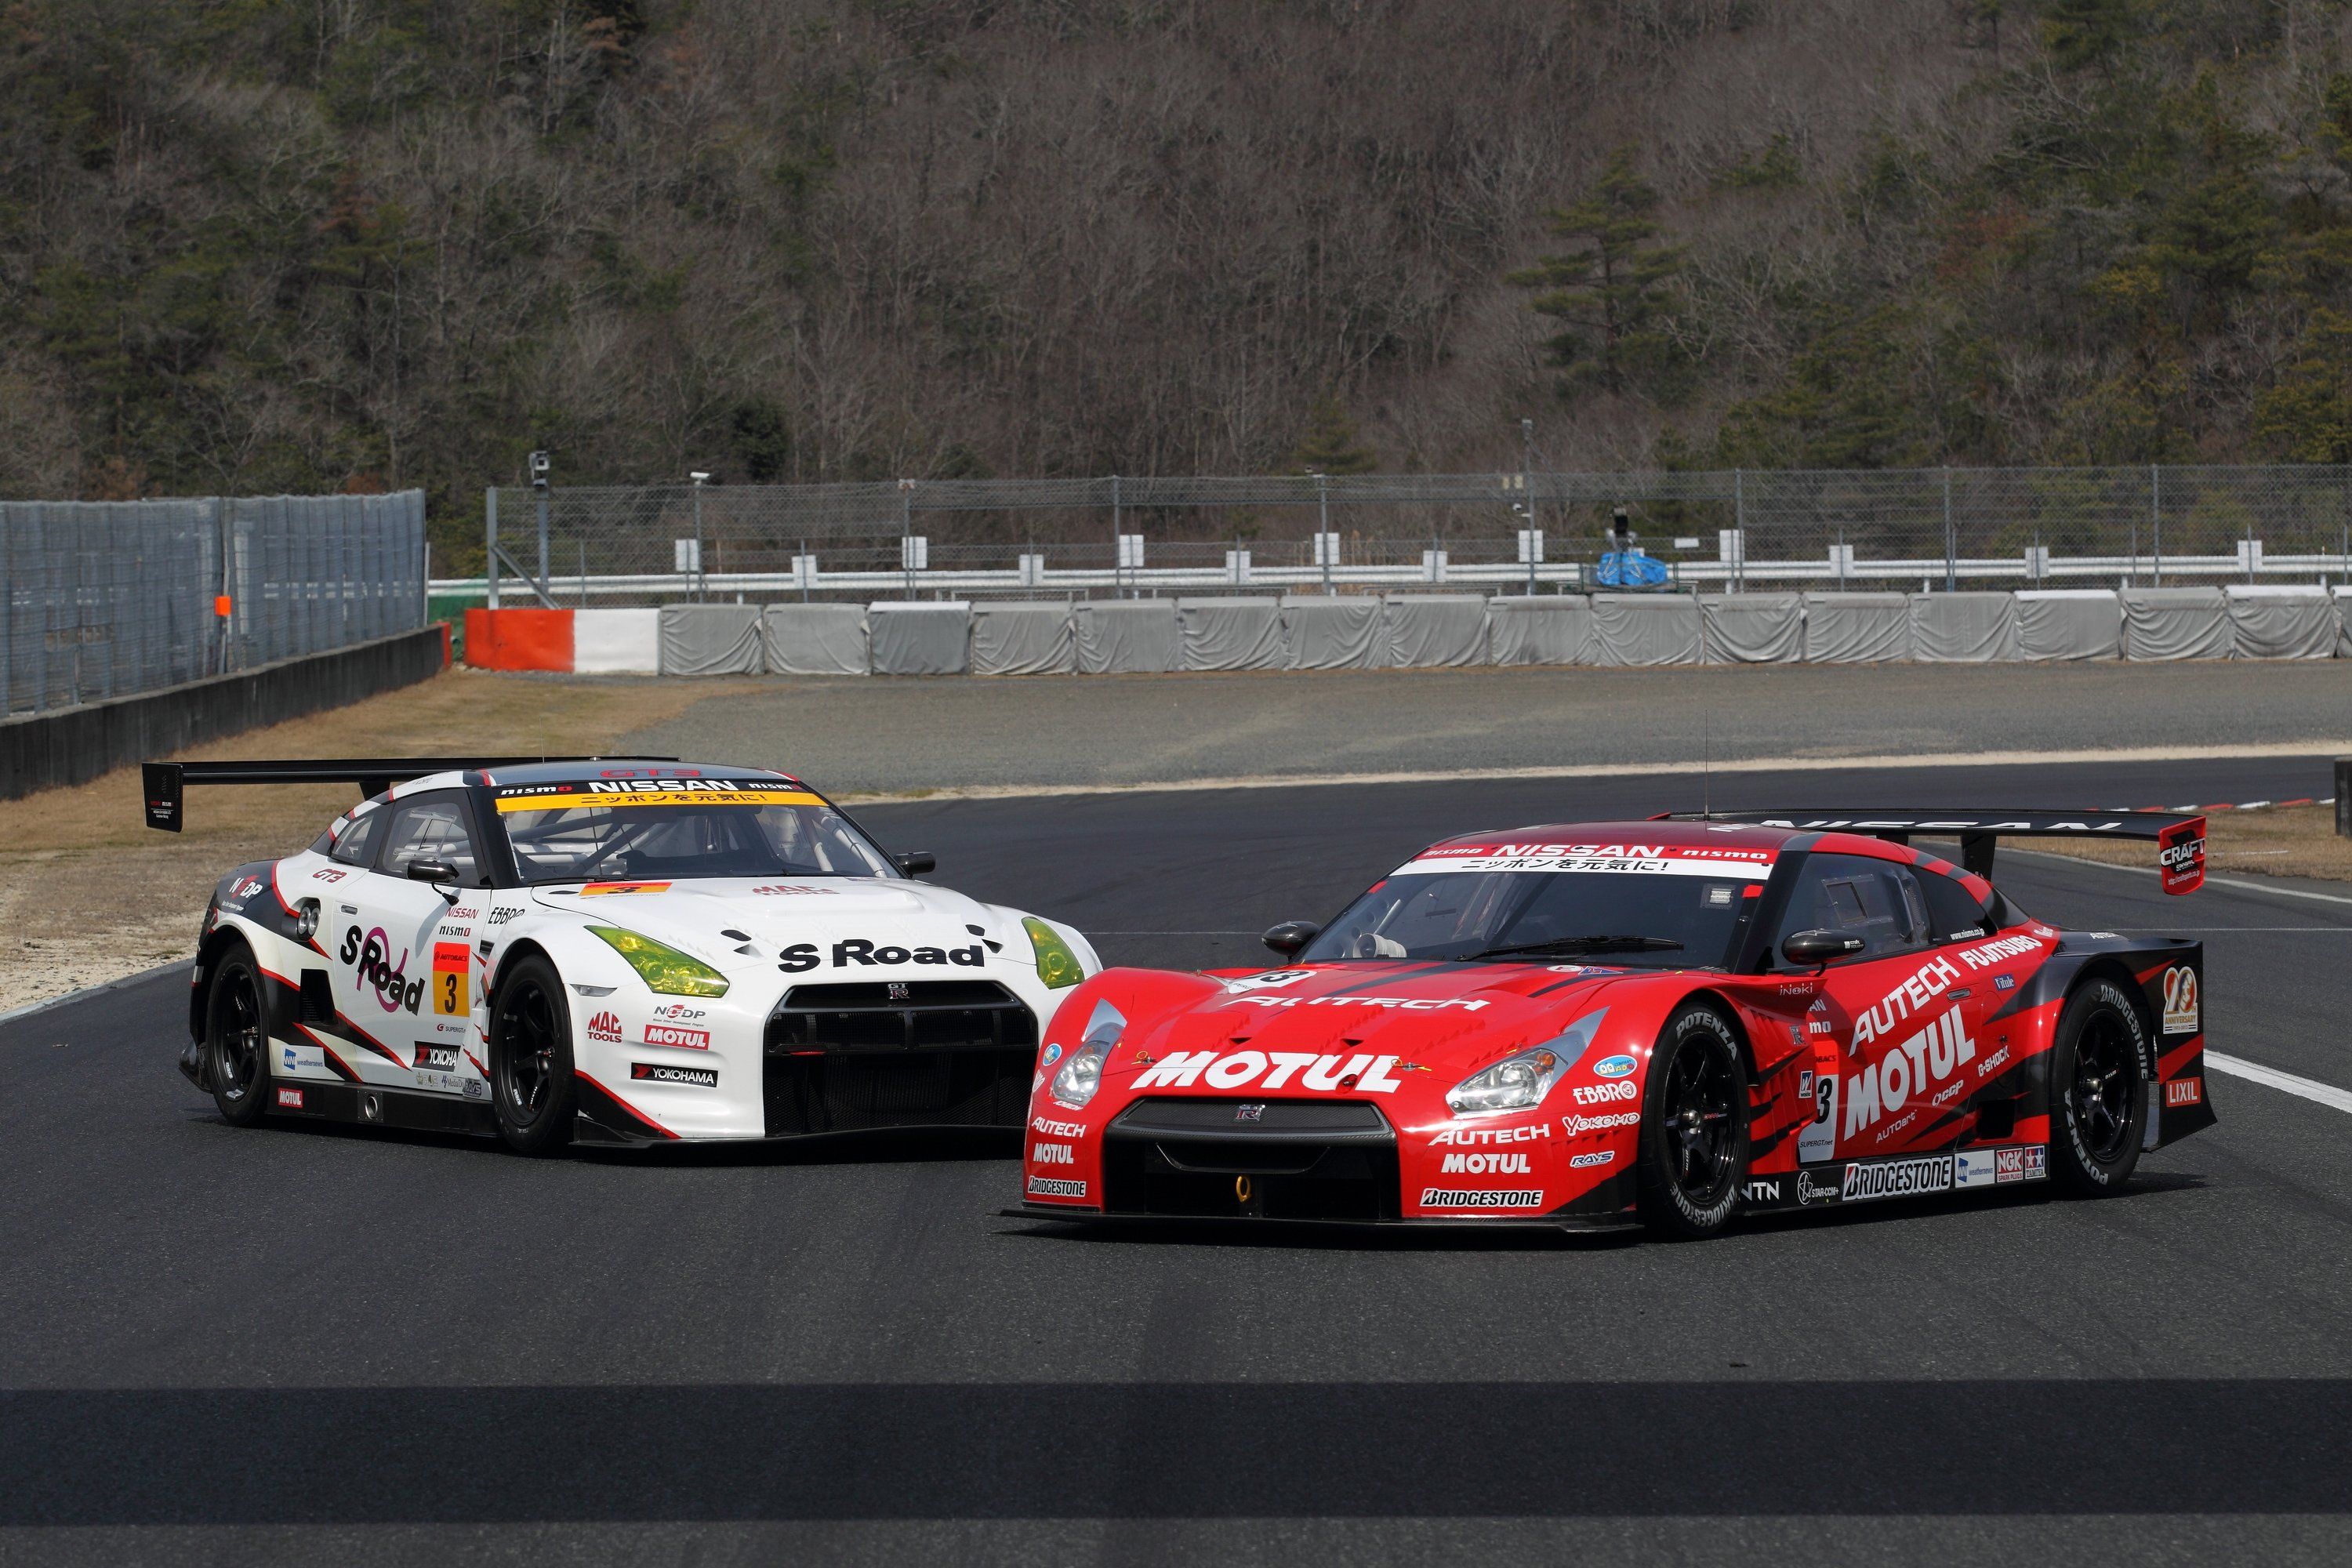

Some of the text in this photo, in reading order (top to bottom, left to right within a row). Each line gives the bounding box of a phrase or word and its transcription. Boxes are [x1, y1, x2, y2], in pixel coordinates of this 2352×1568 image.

[600, 769, 701, 778] GT3
[501, 786, 572, 795] nismo
[588, 780, 739, 793] NISSAN
[1492, 844, 1664, 858] NISSAN
[1682, 850, 1768, 860] nismo
[2161, 837, 2205, 866] CRAFT
[313, 869, 347, 884] GT3
[445, 907, 479, 920] NISSAN
[438, 925, 471, 937] nismo
[439, 953, 468, 962] AUTOBACS
[778, 938, 985, 974] S Road
[1958, 935, 2043, 971] FUJITSUBO
[340, 924, 426, 1016] S Road
[445, 974, 457, 1014] 3
[1219, 996, 1492, 1011] AUTECH
[1849, 955, 1961, 1058] AUTECH
[588, 1011, 622, 1035] MAC
[2165, 1014, 2196, 1025] ANNIVERSARY
[587, 1031, 622, 1044] TOOLS
[647, 1028, 706, 1047] MOTUL
[1675, 1011, 1739, 1060] POTENZA
[2100, 985, 2149, 1080] BRIDGESTONE
[1978, 1045, 2010, 1077] G-SHOCK
[652, 1067, 715, 1084] YOKOHAMA
[1129, 1051, 1402, 1094] MOTUL
[1843, 1004, 1976, 1142] MOTUL
[280, 1090, 302, 1105] MOTUL
[1573, 1080, 1637, 1105] EBBRO
[1814, 1078, 1833, 1124] 3
[2169, 1081, 2198, 1104] LIXIL
[1032, 1116, 1087, 1138] AUTECH
[1428, 1123, 1550, 1146] AUTECH
[2064, 1088, 2109, 1186] POTENZA
[1033, 1143, 1074, 1164] MOTUL
[1799, 1139, 1833, 1149] SUPERGT.net
[1441, 1153, 1531, 1174] MOTUL
[1571, 1152, 1613, 1166] RAYS
[1998, 1150, 2023, 1173] NGK
[1844, 1158, 1951, 1199] BRIDGESTONE
[1969, 1167, 1994, 1176] weathernews
[1029, 1175, 1086, 1196] BRIDGESTONE
[1421, 1188, 1542, 1206] BRIDGESTONE
